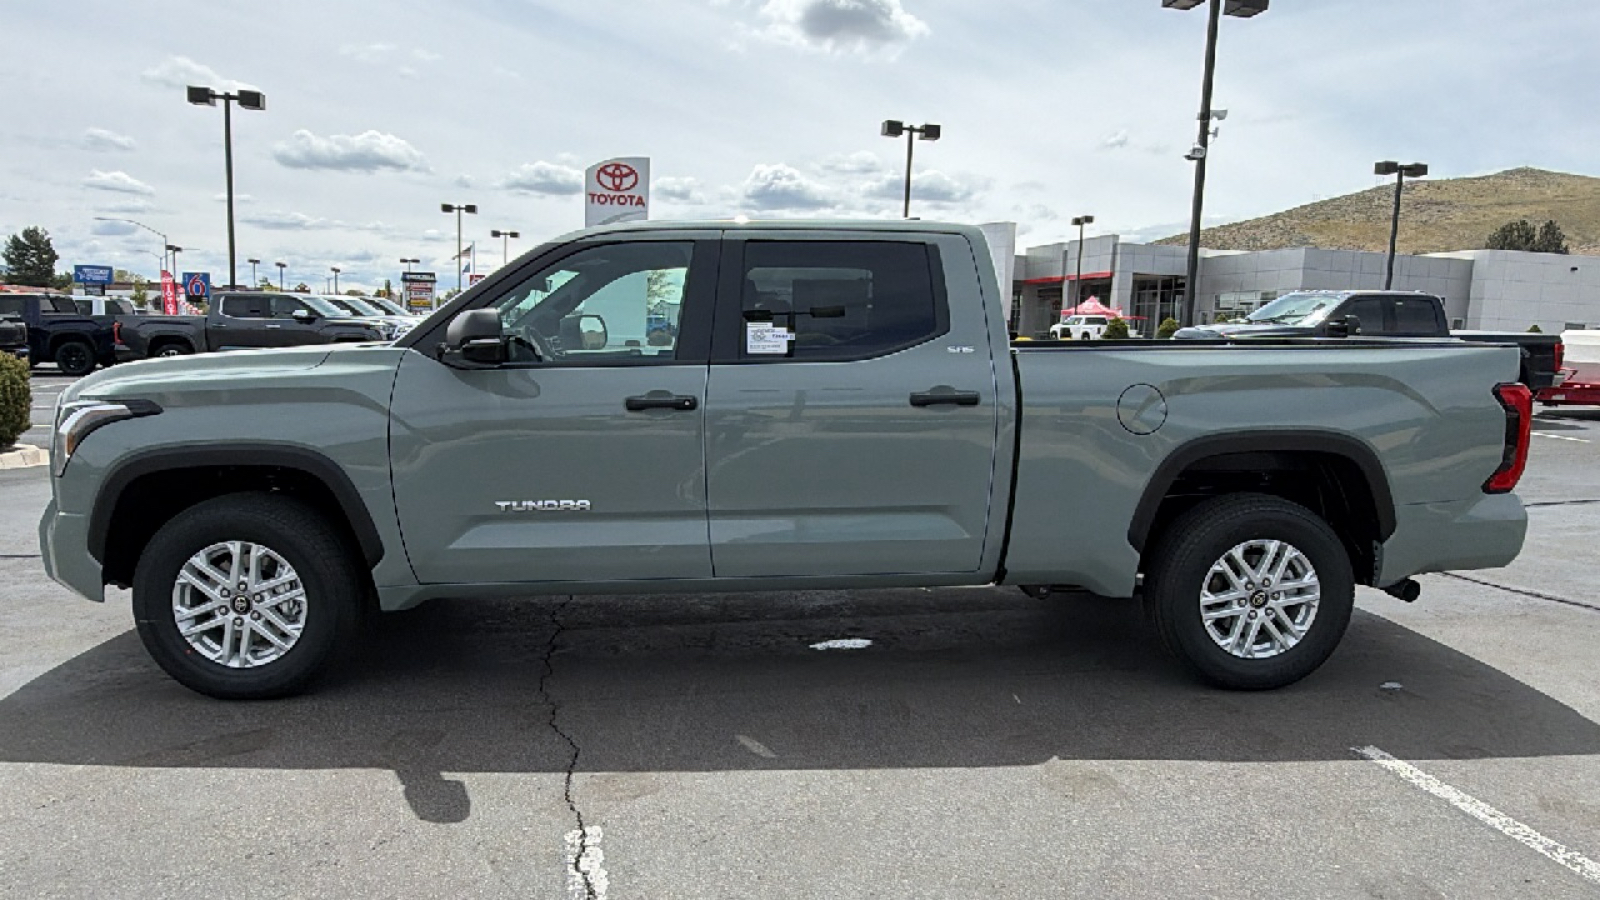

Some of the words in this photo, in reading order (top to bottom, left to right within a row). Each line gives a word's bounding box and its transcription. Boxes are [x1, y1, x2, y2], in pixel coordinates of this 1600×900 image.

[588, 193, 646, 207] TOYOTA
[188, 273, 206, 297] 6
[494, 499, 591, 512] TUNDRA
